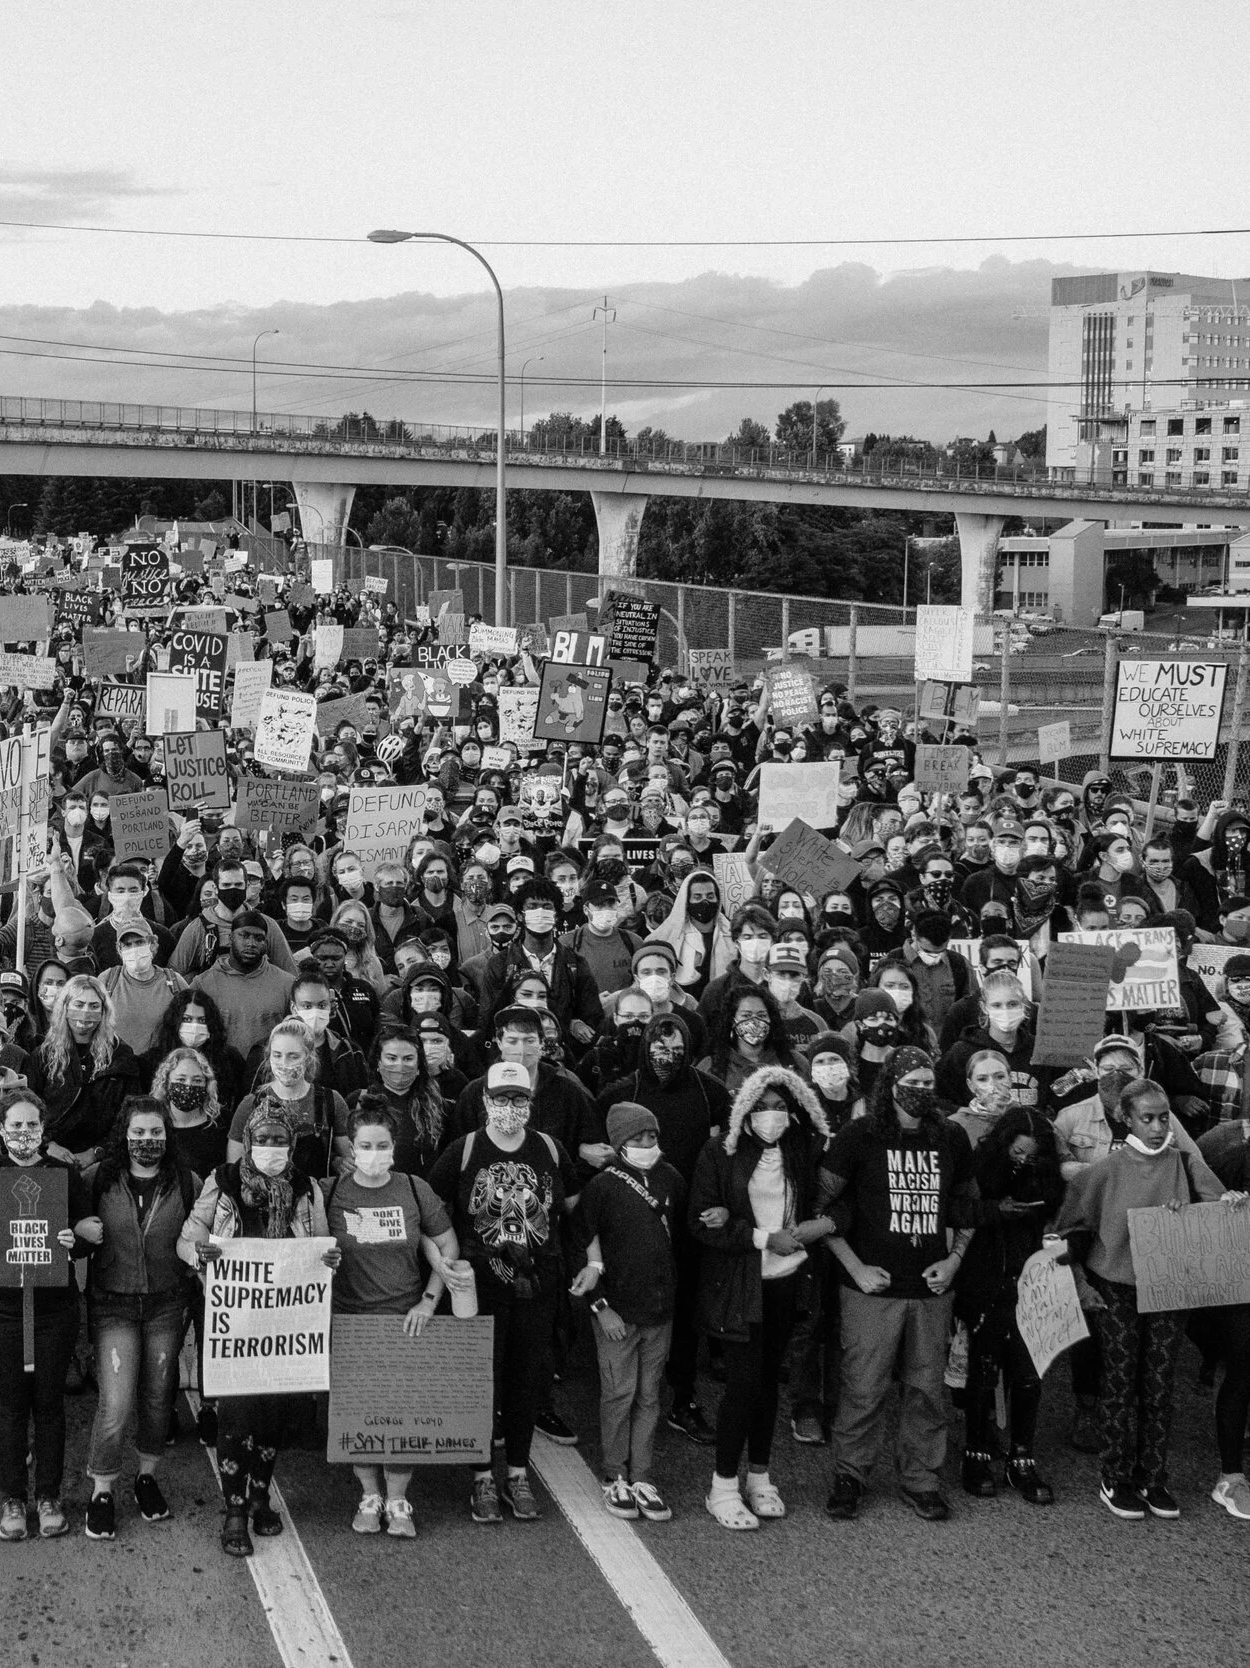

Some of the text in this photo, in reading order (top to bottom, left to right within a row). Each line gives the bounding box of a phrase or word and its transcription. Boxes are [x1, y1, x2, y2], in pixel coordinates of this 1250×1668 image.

[129, 550, 161, 566] NO
[122, 565, 169, 589] justice
[131, 579, 162, 595] NO
[65, 592, 93, 605] BLACK
[64, 603, 88, 612] LIVES
[630, 603, 642, 611] YOU
[642, 604, 655, 612] ARE
[59, 612, 92, 623] MATTER
[616, 611, 658, 620] NEUTRAL IN
[616, 619, 650, 628] SITUATIONS
[622, 626, 656, 636] INJUSTICE
[173, 632, 223, 656] COVID
[612, 639, 623, 647] THE
[623, 640, 638, 648] SIDE
[613, 632, 639, 641] YOU HAVE
[418, 645, 466, 662] BLACK
[552, 631, 606, 667] BLM
[183, 653, 211, 668] IS A
[691, 651, 732, 664] SPEAK
[779, 671, 792, 679] NO
[1123, 663, 1227, 687] WE MUST
[773, 678, 805, 690] JUSTICE
[265, 691, 315, 704] DEFUND POLICE
[772, 687, 809, 699] NO PEACE
[1118, 687, 1189, 702] EDUCATE
[772, 696, 812, 708] NO RACIST
[781, 706, 809, 717] POLICE
[1139, 702, 1217, 718] OURSELVES
[1146, 717, 1184, 728] ABOUT
[1119, 728, 1169, 740] WHITE
[270, 750, 307, 761] RESOURCES
[1135, 740, 1213, 756] SUPREMACY
[266, 755, 305, 766] COMMUNITY
[924, 759, 960, 771] BREAK
[171, 782, 216, 803] ROLL
[245, 781, 318, 802] PORTLAND
[115, 793, 155, 807] DEFUND
[288, 802, 300, 811] BE
[352, 790, 426, 813] DEFUND
[119, 806, 161, 821] DISBAND
[250, 809, 302, 825] BETTER
[121, 820, 165, 835] PORTLAND
[348, 817, 421, 840] DISARM
[124, 837, 165, 852] POLICE
[626, 849, 655, 860] LIVES
[1132, 929, 1175, 948] TRANS
[1198, 965, 1216, 976] NO
[1121, 979, 1179, 1007] MATTER
[886, 1149, 941, 1173] MAKE
[888, 1172, 941, 1191] RACISM
[889, 1193, 940, 1213] WRONG
[372, 1210, 402, 1219] DON'T
[10, 1221, 48, 1236] BLACK
[379, 1218, 403, 1228] GIVE
[889, 1212, 938, 1234] AGAIN
[389, 1228, 403, 1238] UP
[1133, 1207, 1213, 1257] BLACK
[14, 1235, 44, 1249] LIVES
[7, 1250, 51, 1263] MATTER
[212, 1258, 275, 1284] WHITE
[210, 1282, 328, 1311] SUPREMACY
[211, 1312, 230, 1335] IS
[209, 1332, 326, 1359] TERRORISM
[364, 1415, 444, 1427] GEORGE FLOYD
[389, 1435, 433, 1451] THEIR
[435, 1437, 477, 1450] NAMES
